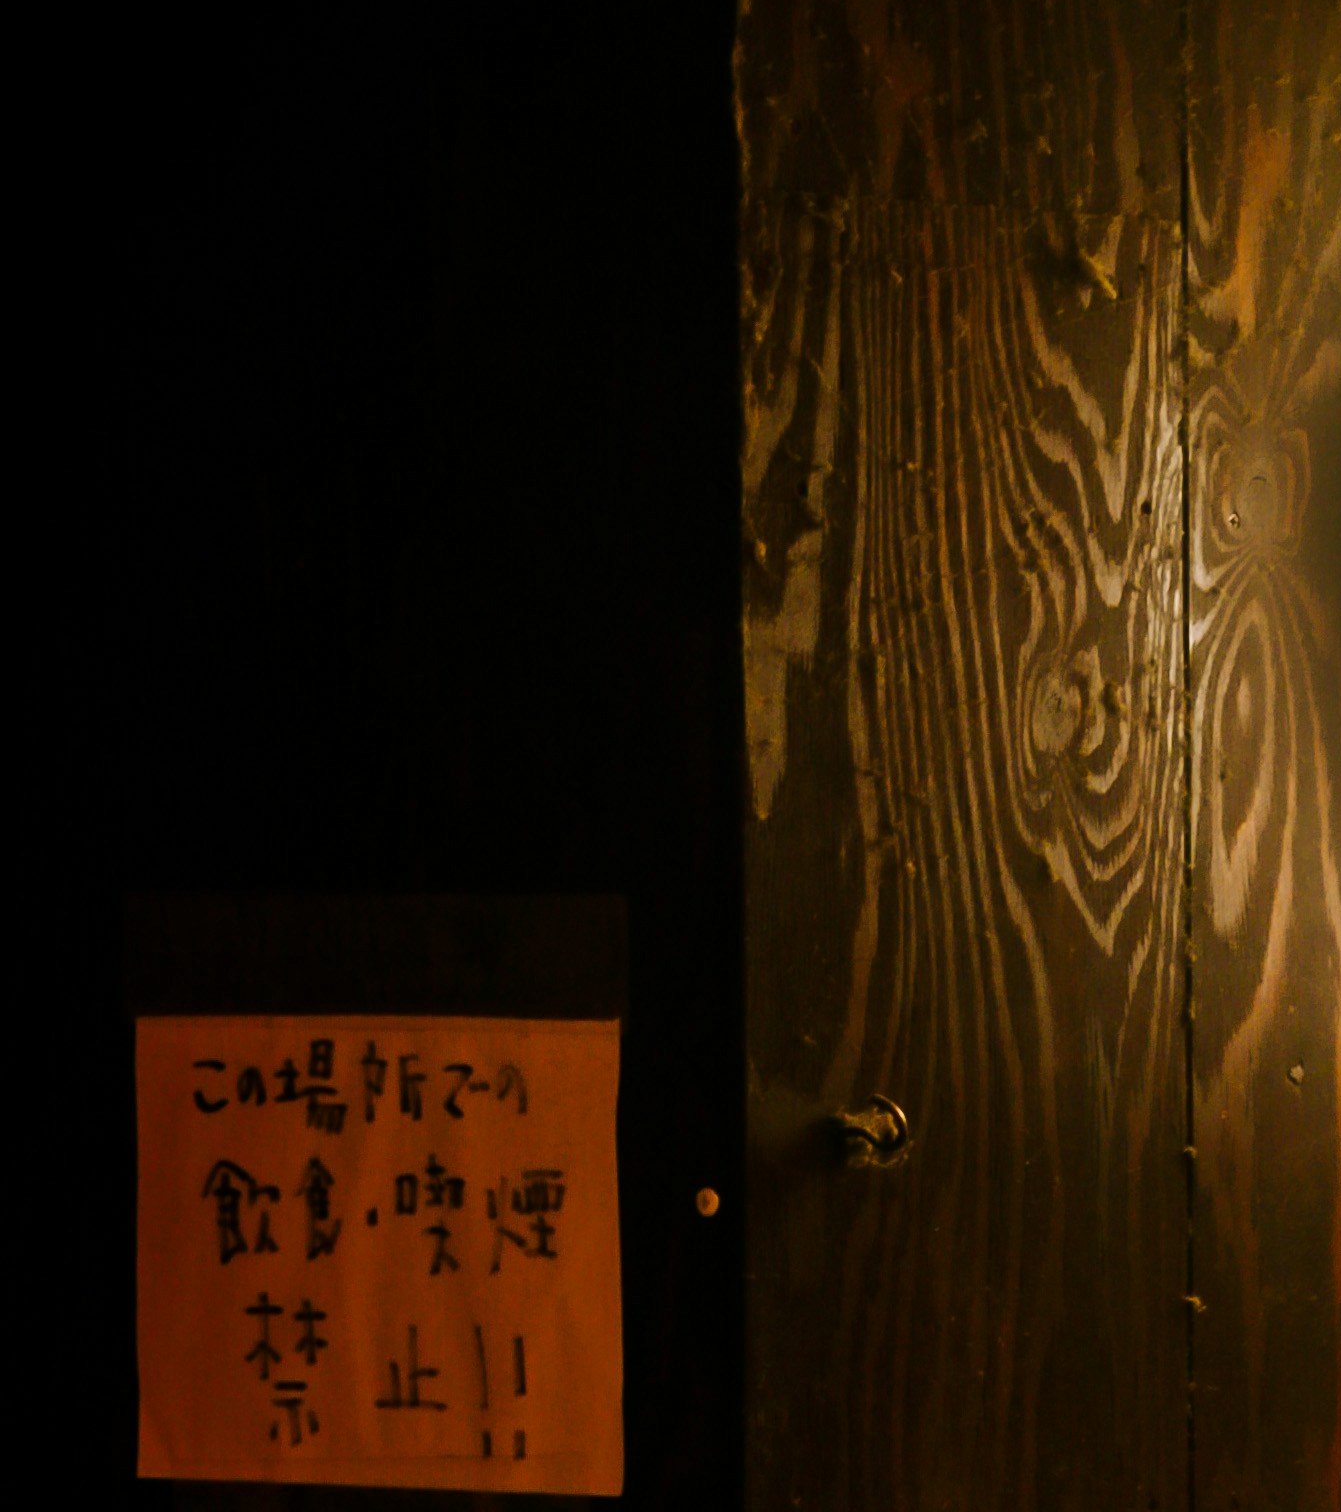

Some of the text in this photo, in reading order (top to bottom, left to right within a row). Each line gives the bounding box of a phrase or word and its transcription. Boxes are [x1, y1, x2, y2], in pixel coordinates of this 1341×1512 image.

[193, 1038, 529, 1134] この場所での
